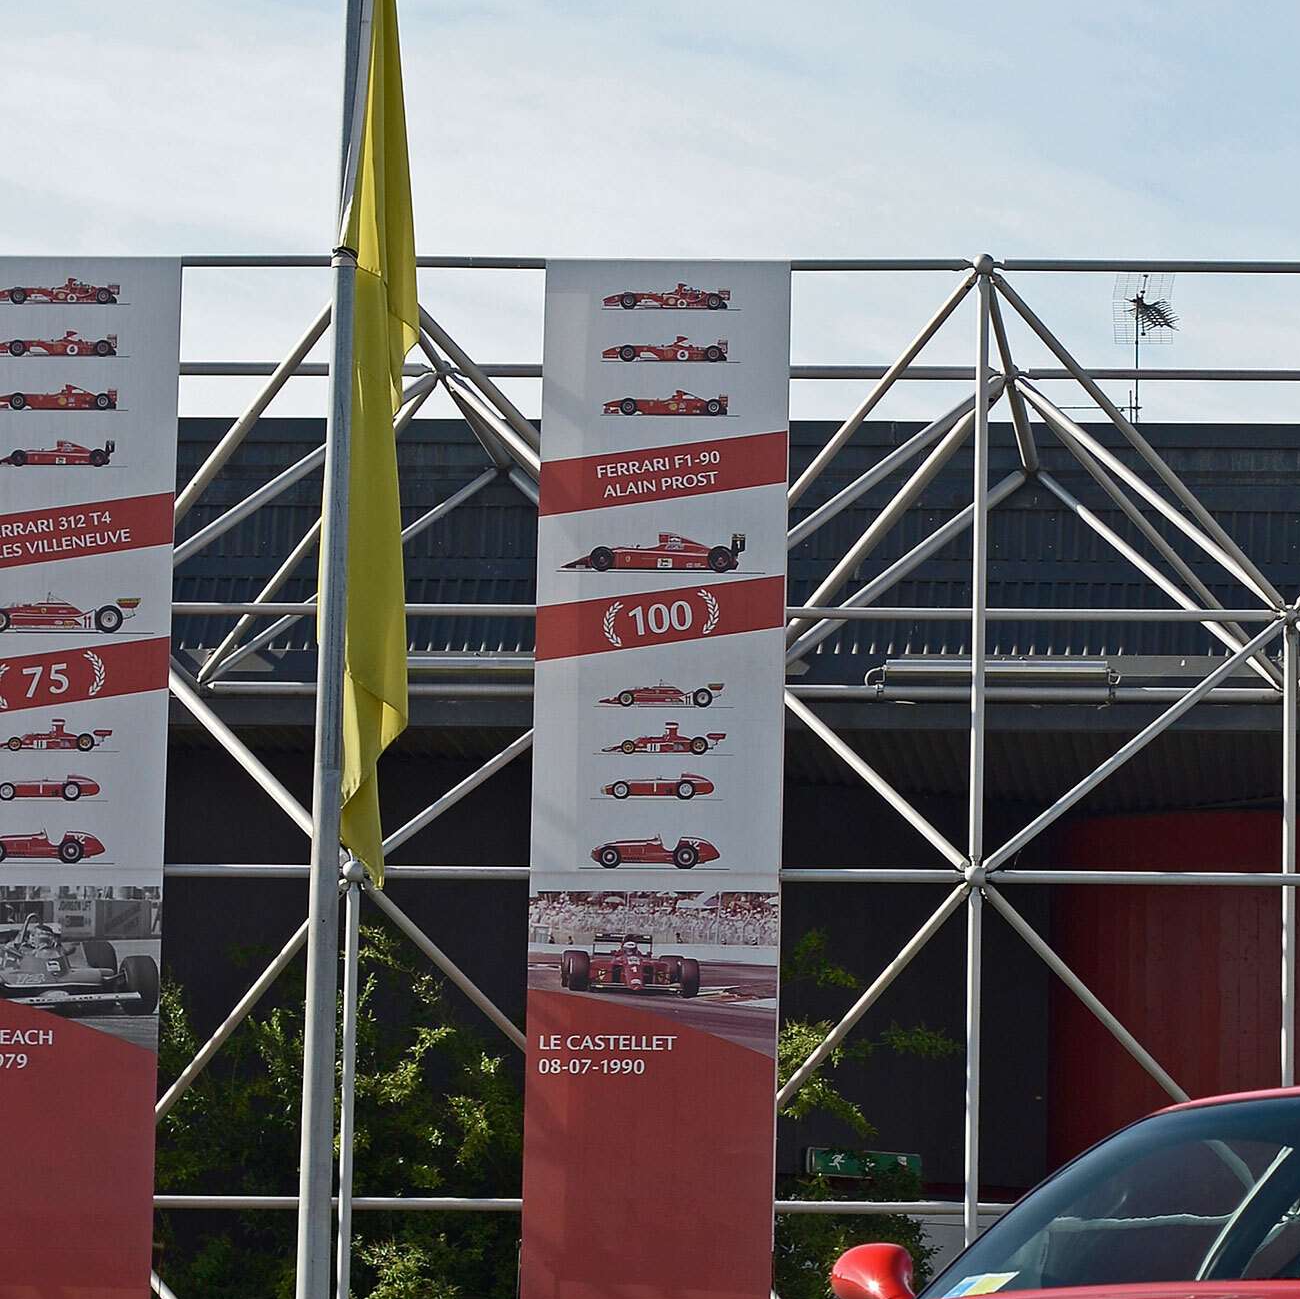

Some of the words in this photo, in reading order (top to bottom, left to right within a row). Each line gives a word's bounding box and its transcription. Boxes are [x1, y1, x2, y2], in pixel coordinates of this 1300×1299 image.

[596, 457, 670, 478] FERRARI
[674, 450, 720, 469] F1-90
[603, 479, 657, 499] ALAIN
[661, 471, 719, 491] PROST
[0, 518, 54, 538] RRARI
[58, 514, 86, 531] 312
[89, 510, 112, 526] T4
[26, 528, 131, 554] VILLENEUVE
[628, 600, 693, 636] 100
[22, 662, 70, 698] 75
[538, 1034, 562, 1051] LE
[566, 1034, 677, 1051] CASTELLET
[538, 1058, 645, 1075] 08-07-1990
